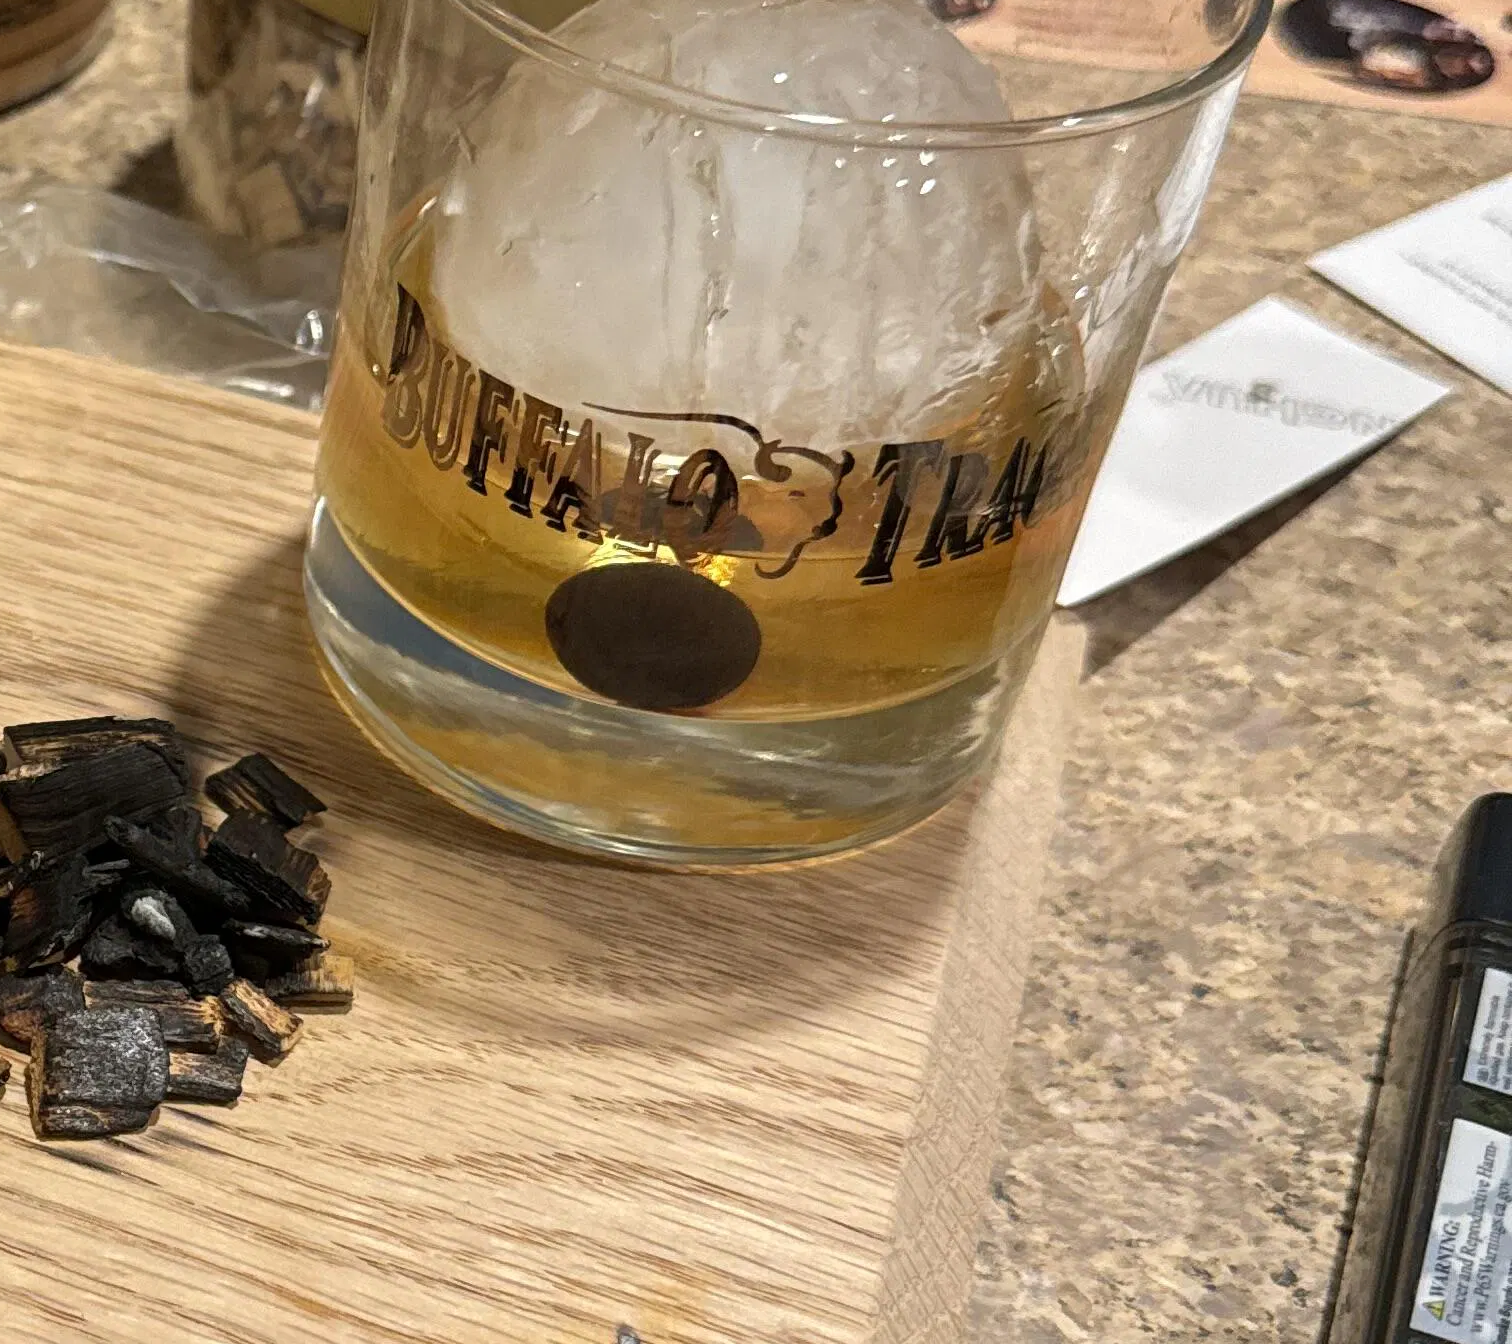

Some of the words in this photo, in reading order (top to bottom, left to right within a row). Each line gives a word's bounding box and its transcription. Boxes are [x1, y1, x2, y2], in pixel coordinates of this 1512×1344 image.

[382, 280, 745, 566] BUFFALO
[1460, 1179, 1490, 1256] Reproductive
[1429, 1219, 1460, 1297] WARNING:
[1458, 1258, 1475, 1282] and
[1445, 1284, 1468, 1328] Cancer
